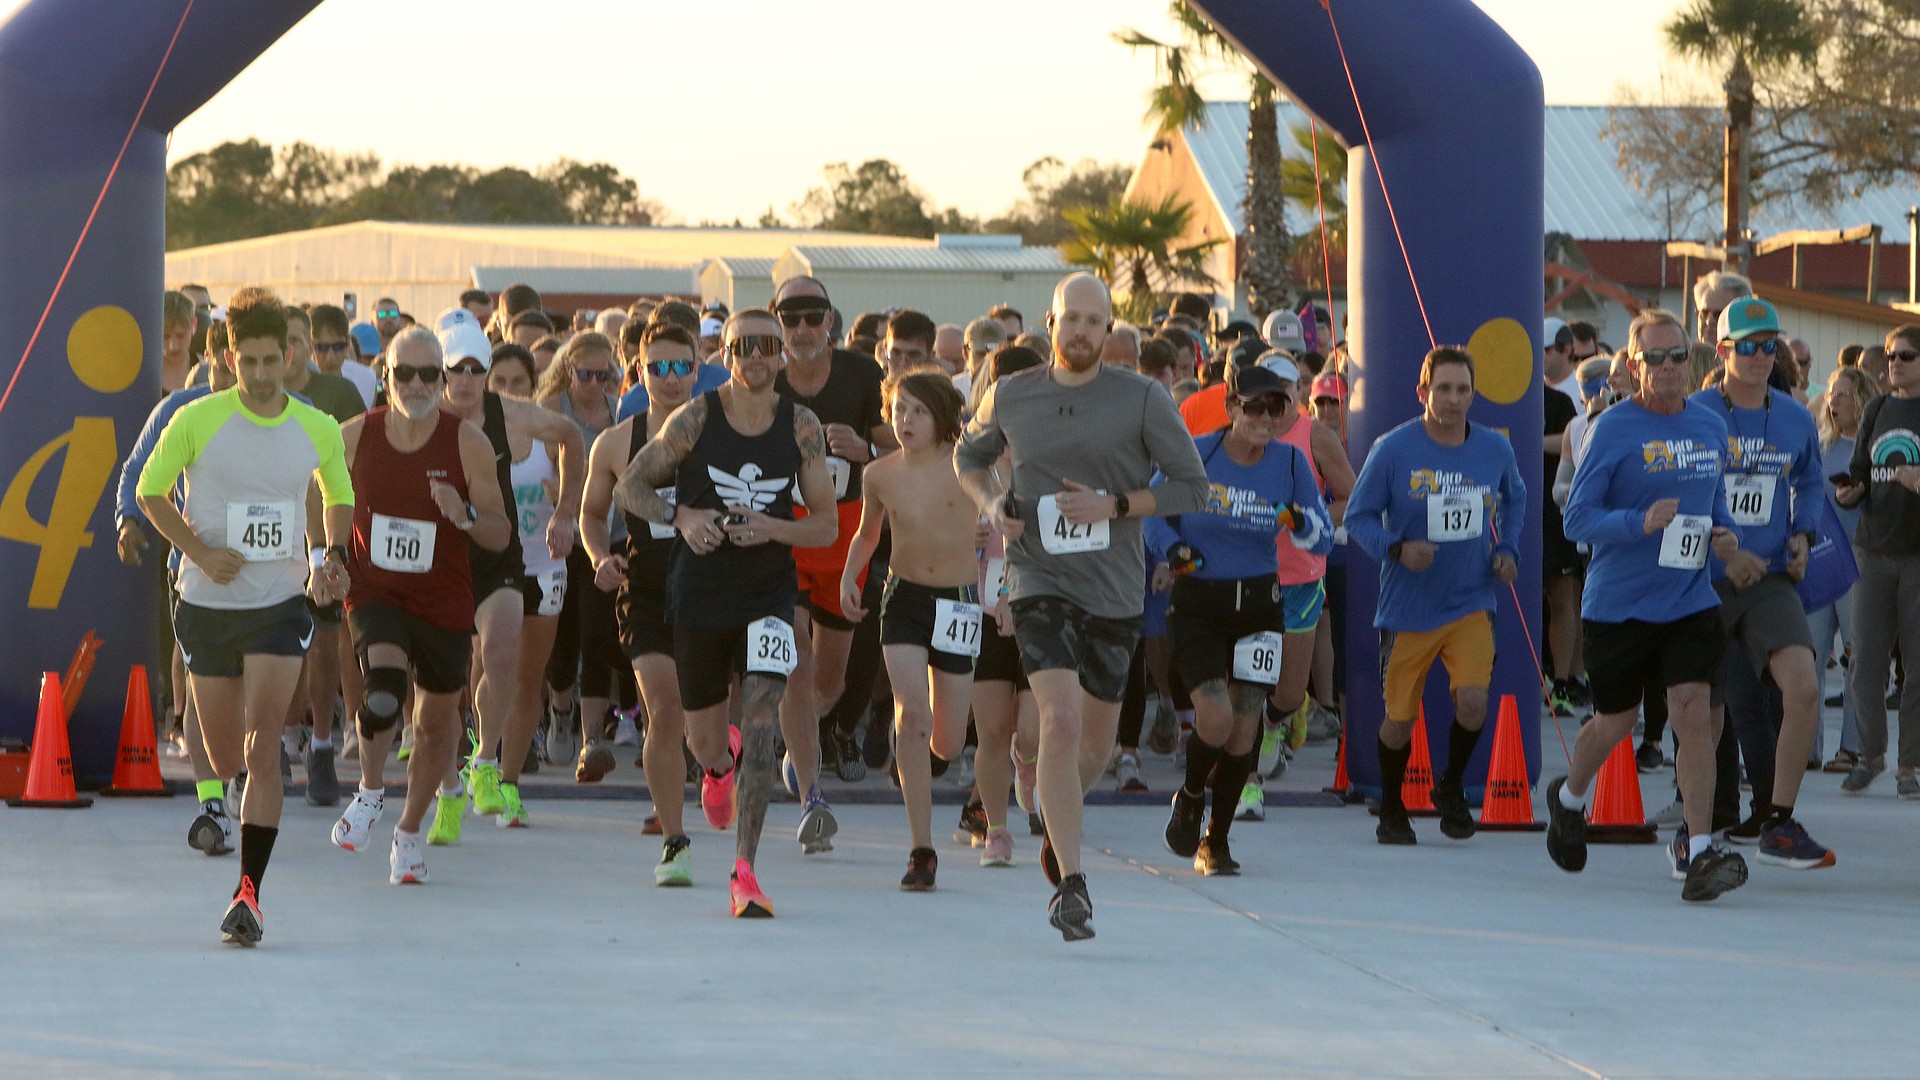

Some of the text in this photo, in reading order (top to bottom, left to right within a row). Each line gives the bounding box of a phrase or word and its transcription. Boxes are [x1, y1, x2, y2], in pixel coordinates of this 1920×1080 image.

[1666, 439, 1694, 455] Race
[1737, 436, 1765, 452] Race
[1435, 470, 1463, 485] Race
[1227, 486, 1256, 503] Race
[1731, 491, 1763, 515] 140
[1250, 514, 1275, 528] Rotary
[1441, 510, 1473, 531] 137
[242, 522, 282, 548] 455
[1680, 534, 1702, 557] 97
[385, 535, 421, 561] 150
[945, 618, 979, 645] 417
[757, 634, 791, 664] 326
[1252, 648, 1275, 672] 96
[1491, 790, 1521, 799] CAUSE
